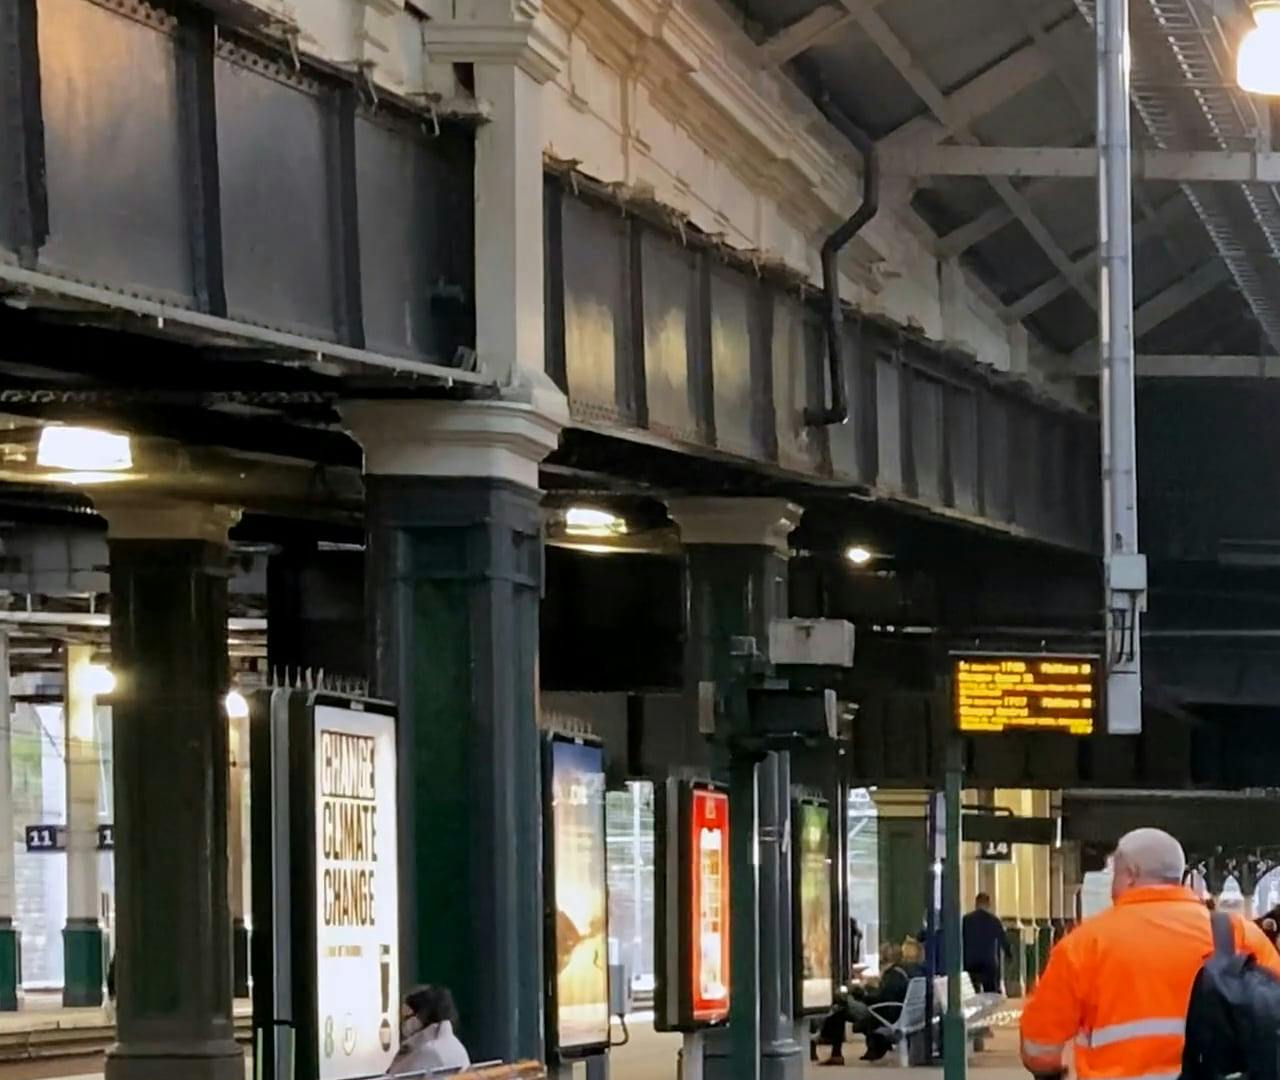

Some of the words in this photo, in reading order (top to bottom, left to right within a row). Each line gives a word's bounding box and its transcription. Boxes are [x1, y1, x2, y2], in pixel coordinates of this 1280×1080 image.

[321, 730, 375, 800] CHANGE
[30, 830, 52, 846] 11
[323, 801, 378, 862] CLIMATE
[986, 842, 1009, 855] 14
[323, 868, 375, 926] CHANGE
